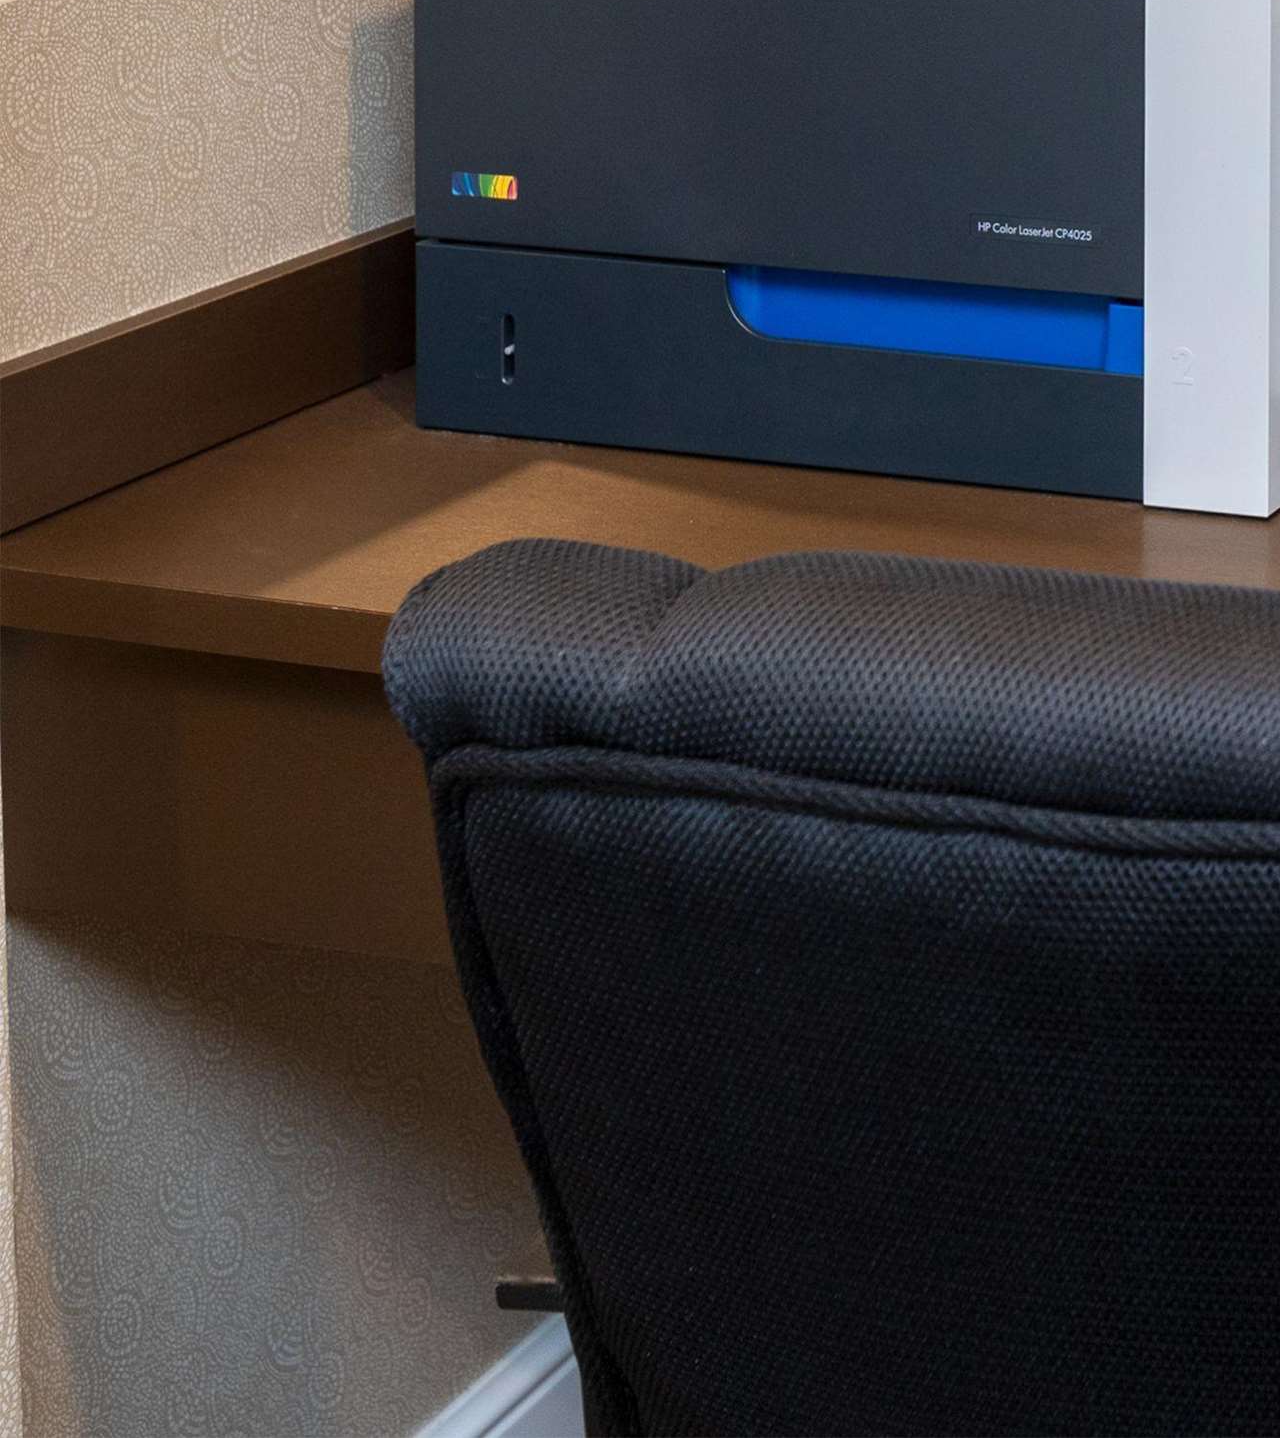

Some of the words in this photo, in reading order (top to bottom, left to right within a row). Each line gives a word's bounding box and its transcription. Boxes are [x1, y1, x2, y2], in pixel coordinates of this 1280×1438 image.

[978, 222, 991, 232] HP
[992, 223, 1017, 235] Color
[1019, 225, 1054, 238] LaserJet
[1054, 228, 1093, 241] CP4025
